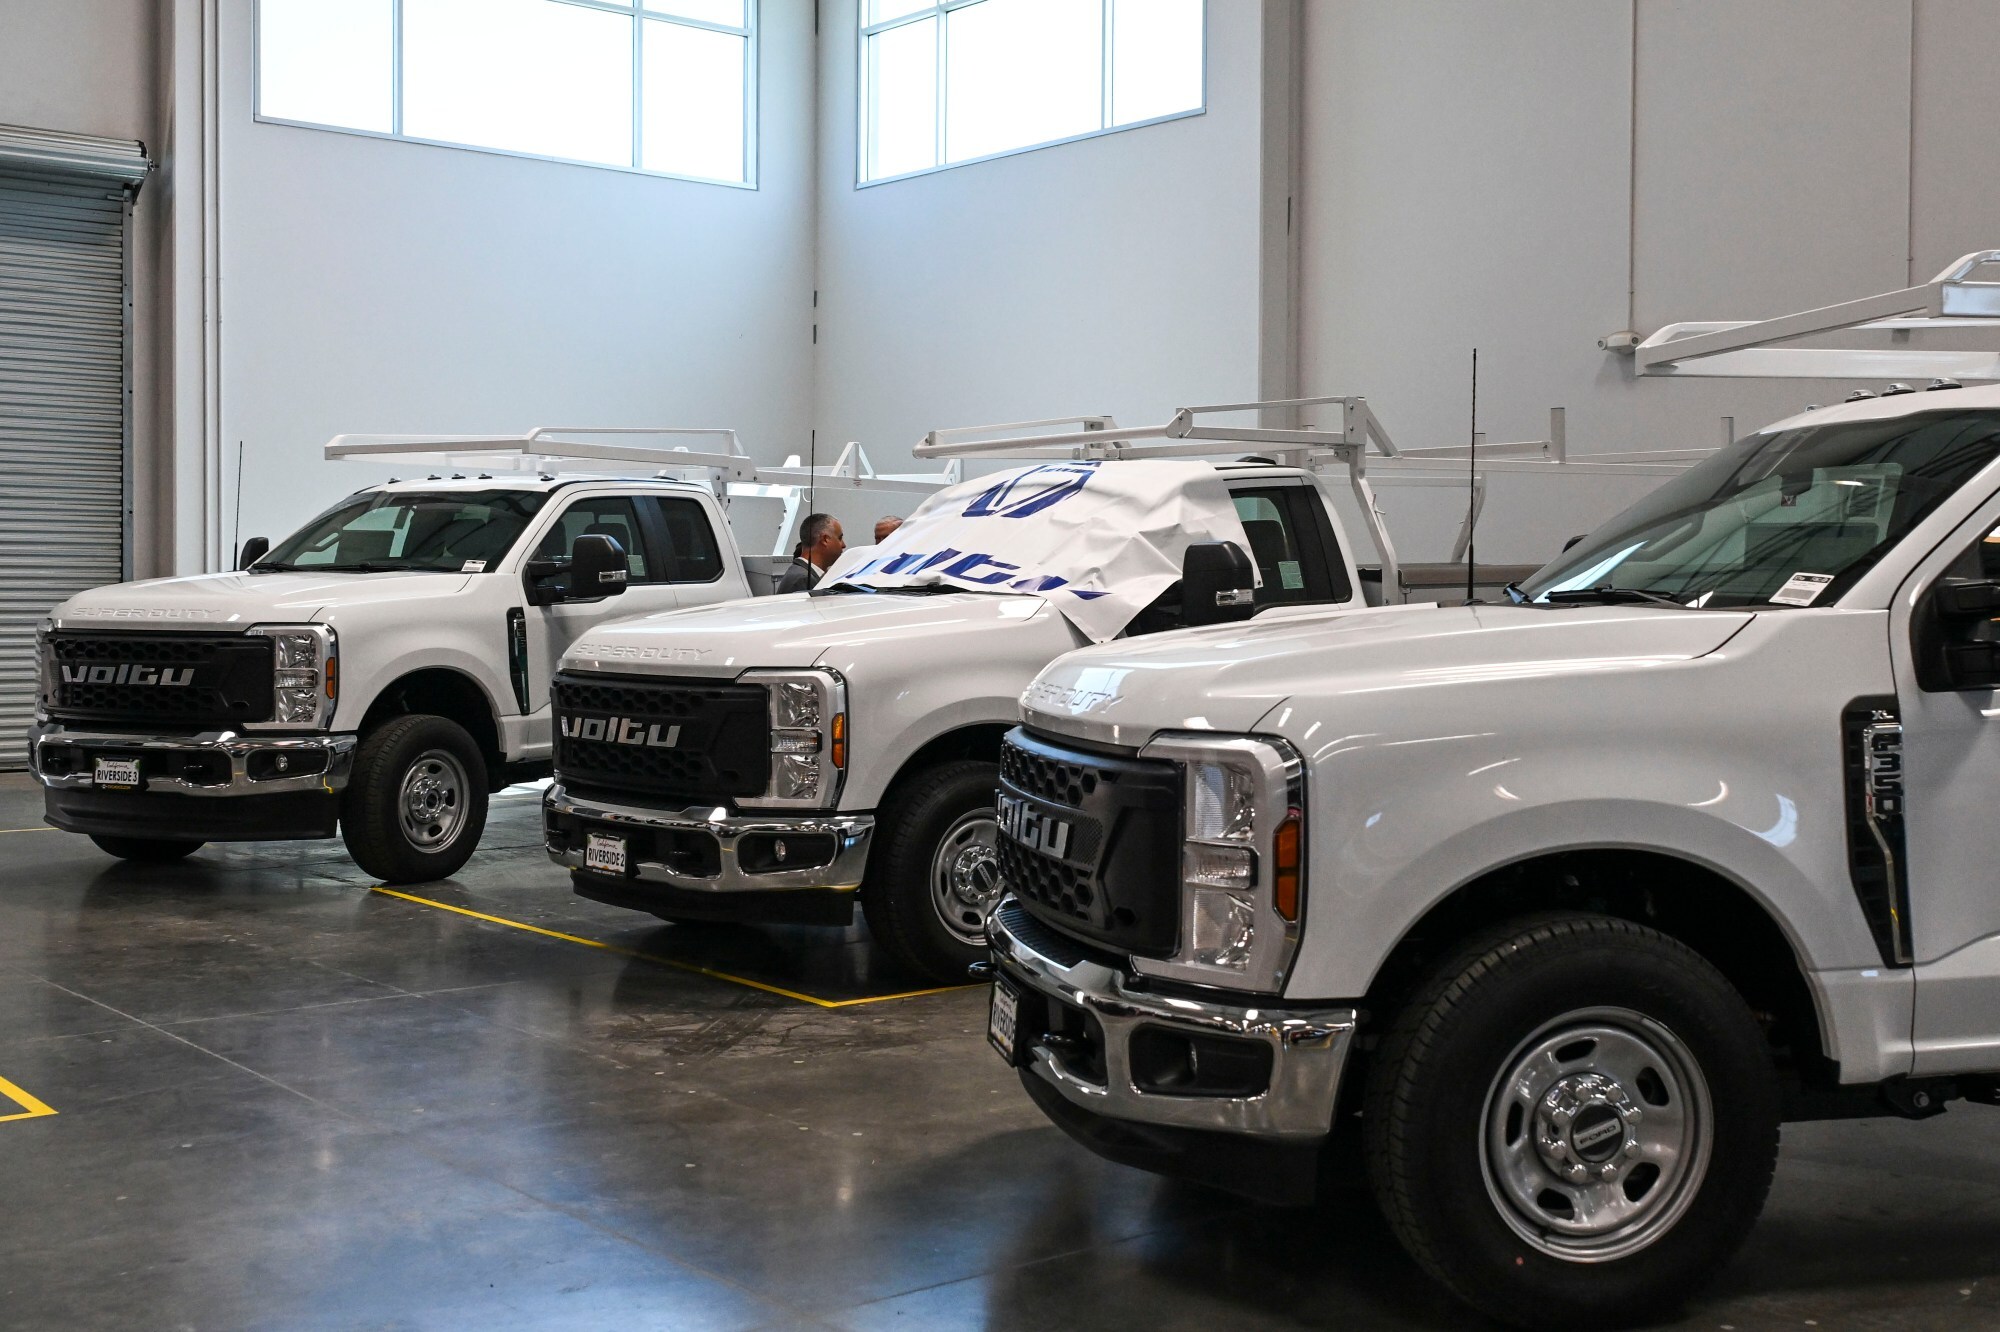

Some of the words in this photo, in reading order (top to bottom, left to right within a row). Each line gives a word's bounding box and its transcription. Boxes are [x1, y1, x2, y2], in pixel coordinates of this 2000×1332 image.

[72, 606, 146, 618] SUPER
[148, 608, 220, 620] DUTY
[639, 647, 713, 661] DUTY
[61, 663, 195, 686] voltu
[1055, 688, 1126, 713] DUTY
[1871, 709, 1895, 720] XL
[560, 715, 681, 748] voltu
[97, 769, 132, 782] RIVERSIDE
[132, 771, 138, 783] 3
[588, 847, 620, 866] RIVERSIDE
[620, 853, 625, 867] 2
[1579, 1125, 1617, 1145] FORD
